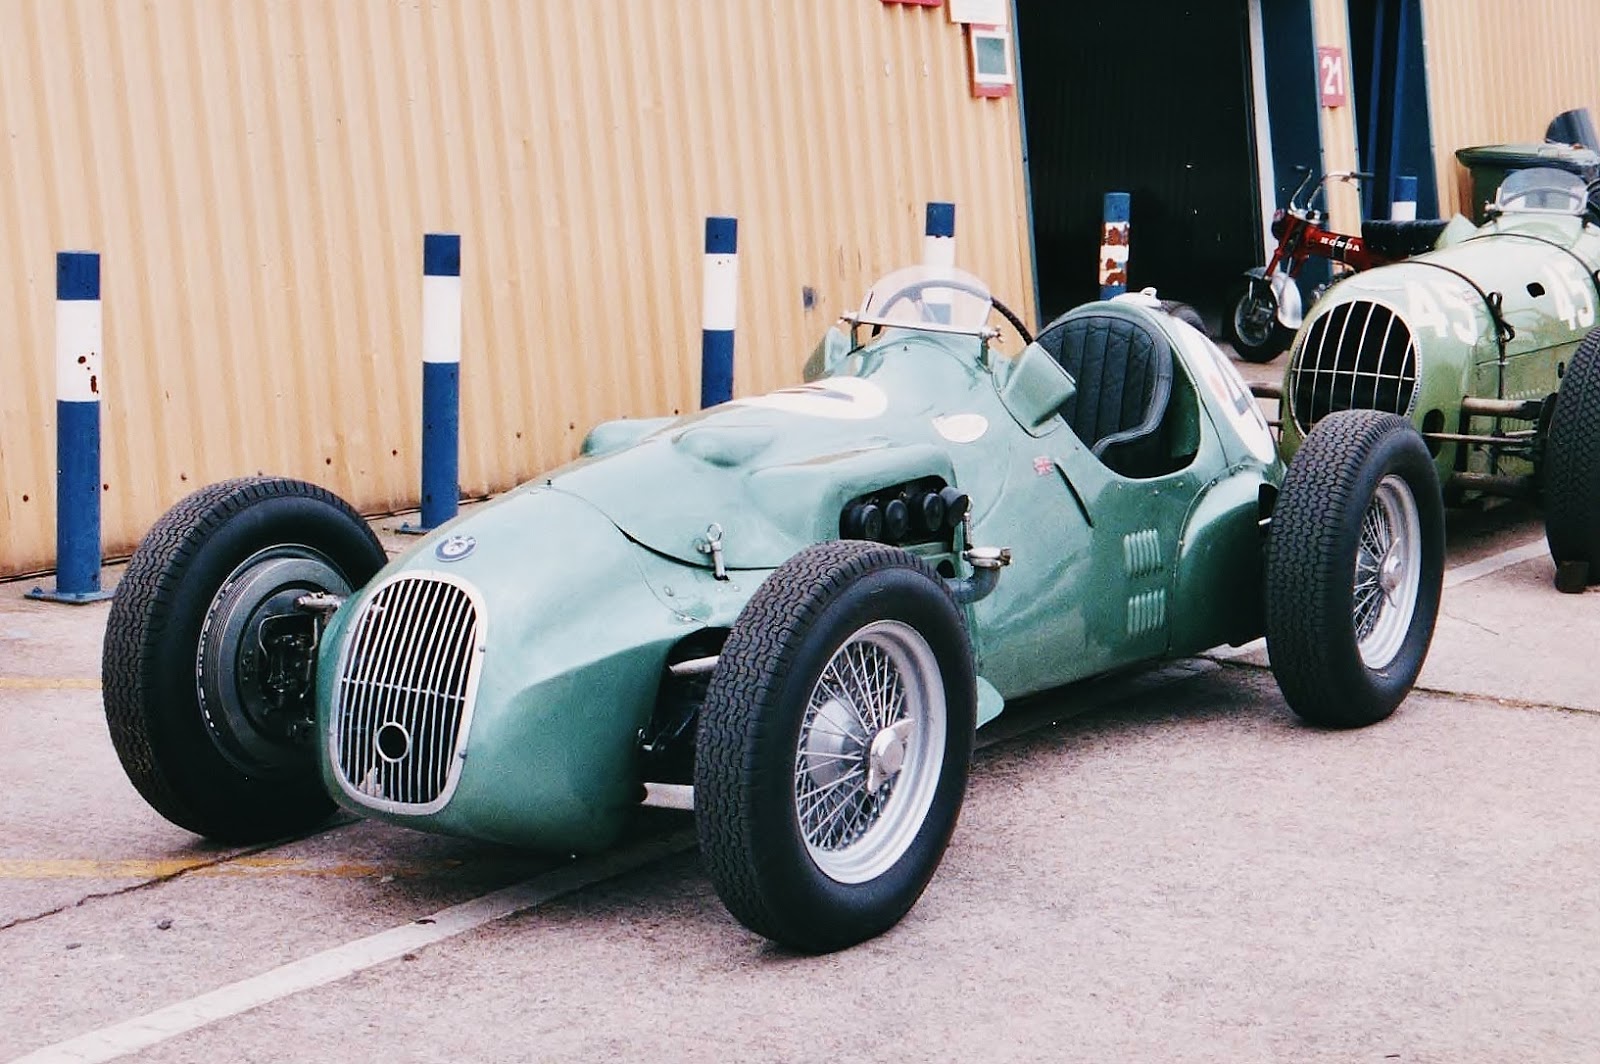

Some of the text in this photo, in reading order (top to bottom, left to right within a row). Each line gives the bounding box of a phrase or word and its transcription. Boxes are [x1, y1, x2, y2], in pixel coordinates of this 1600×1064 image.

[1322, 56, 1344, 96] 21
[1319, 236, 1361, 252] HONDA
[1405, 279, 1479, 346] 45
